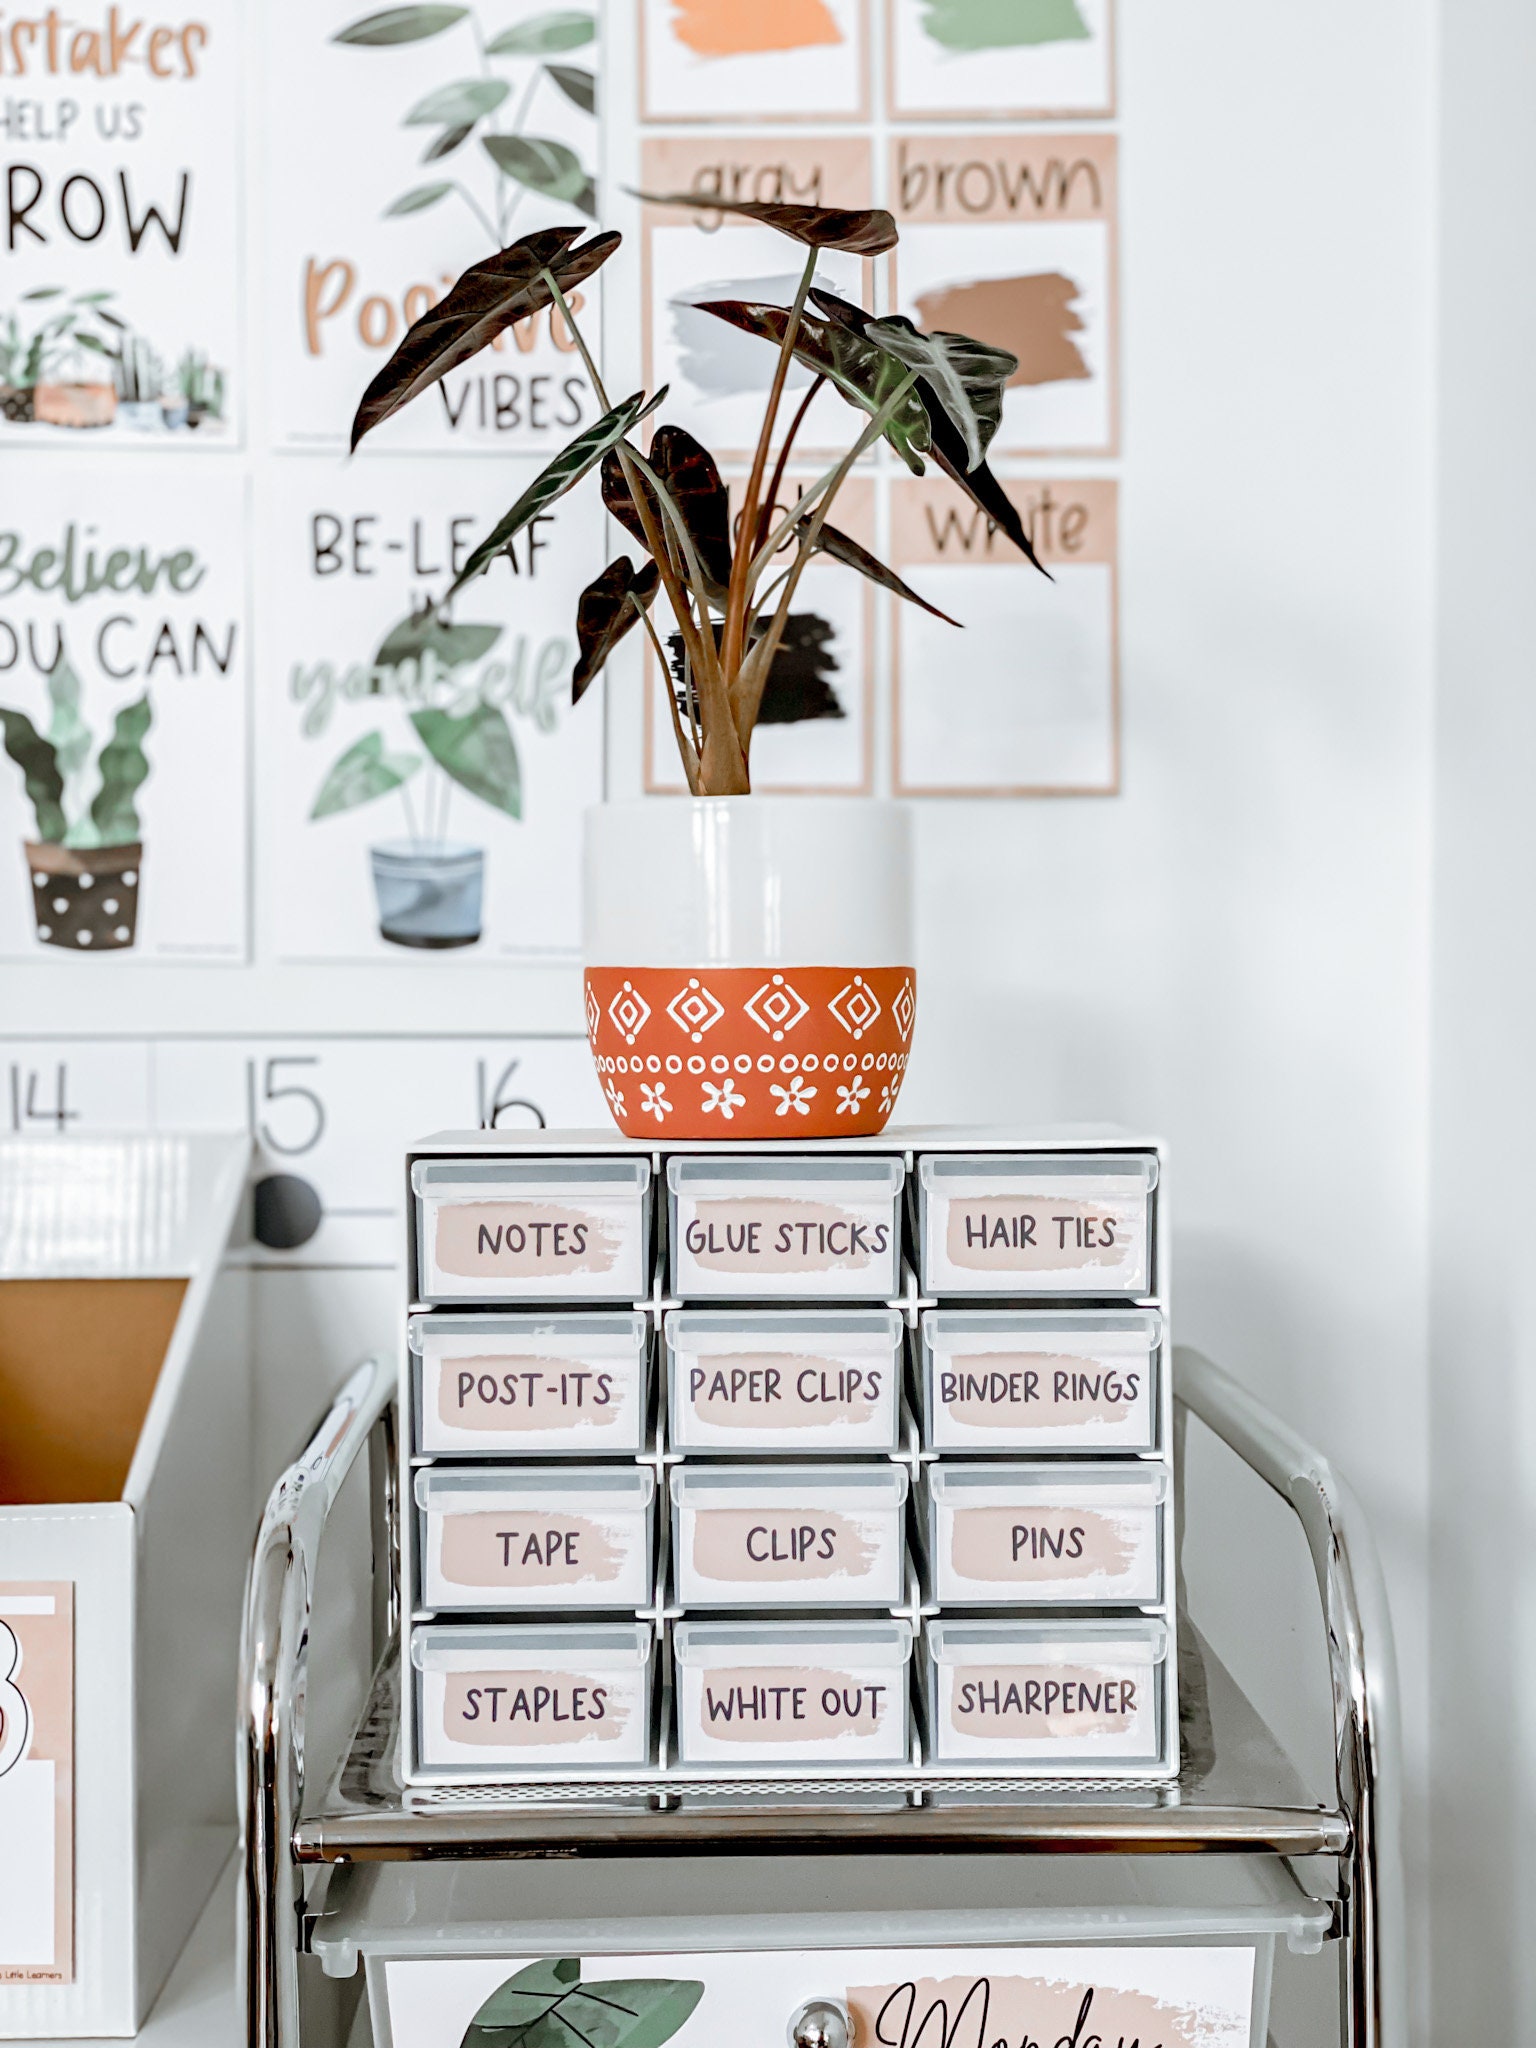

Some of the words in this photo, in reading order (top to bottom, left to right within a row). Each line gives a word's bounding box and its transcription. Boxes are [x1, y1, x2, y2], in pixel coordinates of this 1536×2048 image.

[96, 102, 145, 140] US
[896, 143, 1102, 213] brown
[439, 373, 587, 430] VIBES
[924, 484, 1088, 553] wite
[313, 513, 556, 577] BE-LEAF
[98, 615, 237, 678] CAN
[11, 1062, 79, 1131] 14
[247, 1056, 324, 1154] 15
[478, 1222, 589, 1257] NOTES
[686, 1222, 762, 1256] GLUE
[774, 1221, 890, 1256] STICKS
[965, 1214, 1038, 1250] HAIR
[1051, 1215, 1116, 1250] TIES
[458, 1372, 613, 1408] POST-ITS
[690, 1368, 783, 1403] PAPER
[796, 1369, 882, 1404] CLIPS
[941, 1370, 1041, 1404] BINDER
[1054, 1370, 1141, 1403] RINGS
[495, 1530, 580, 1567] TAPE
[746, 1525, 837, 1562] CLIPS
[1012, 1525, 1085, 1562] PINS
[462, 1686, 608, 1722] STAPLES
[706, 1685, 807, 1722] WHITE
[821, 1686, 887, 1720] OUT
[957, 1678, 1138, 1716] SHARPENER
[26, 1969, 63, 1979] Learners
